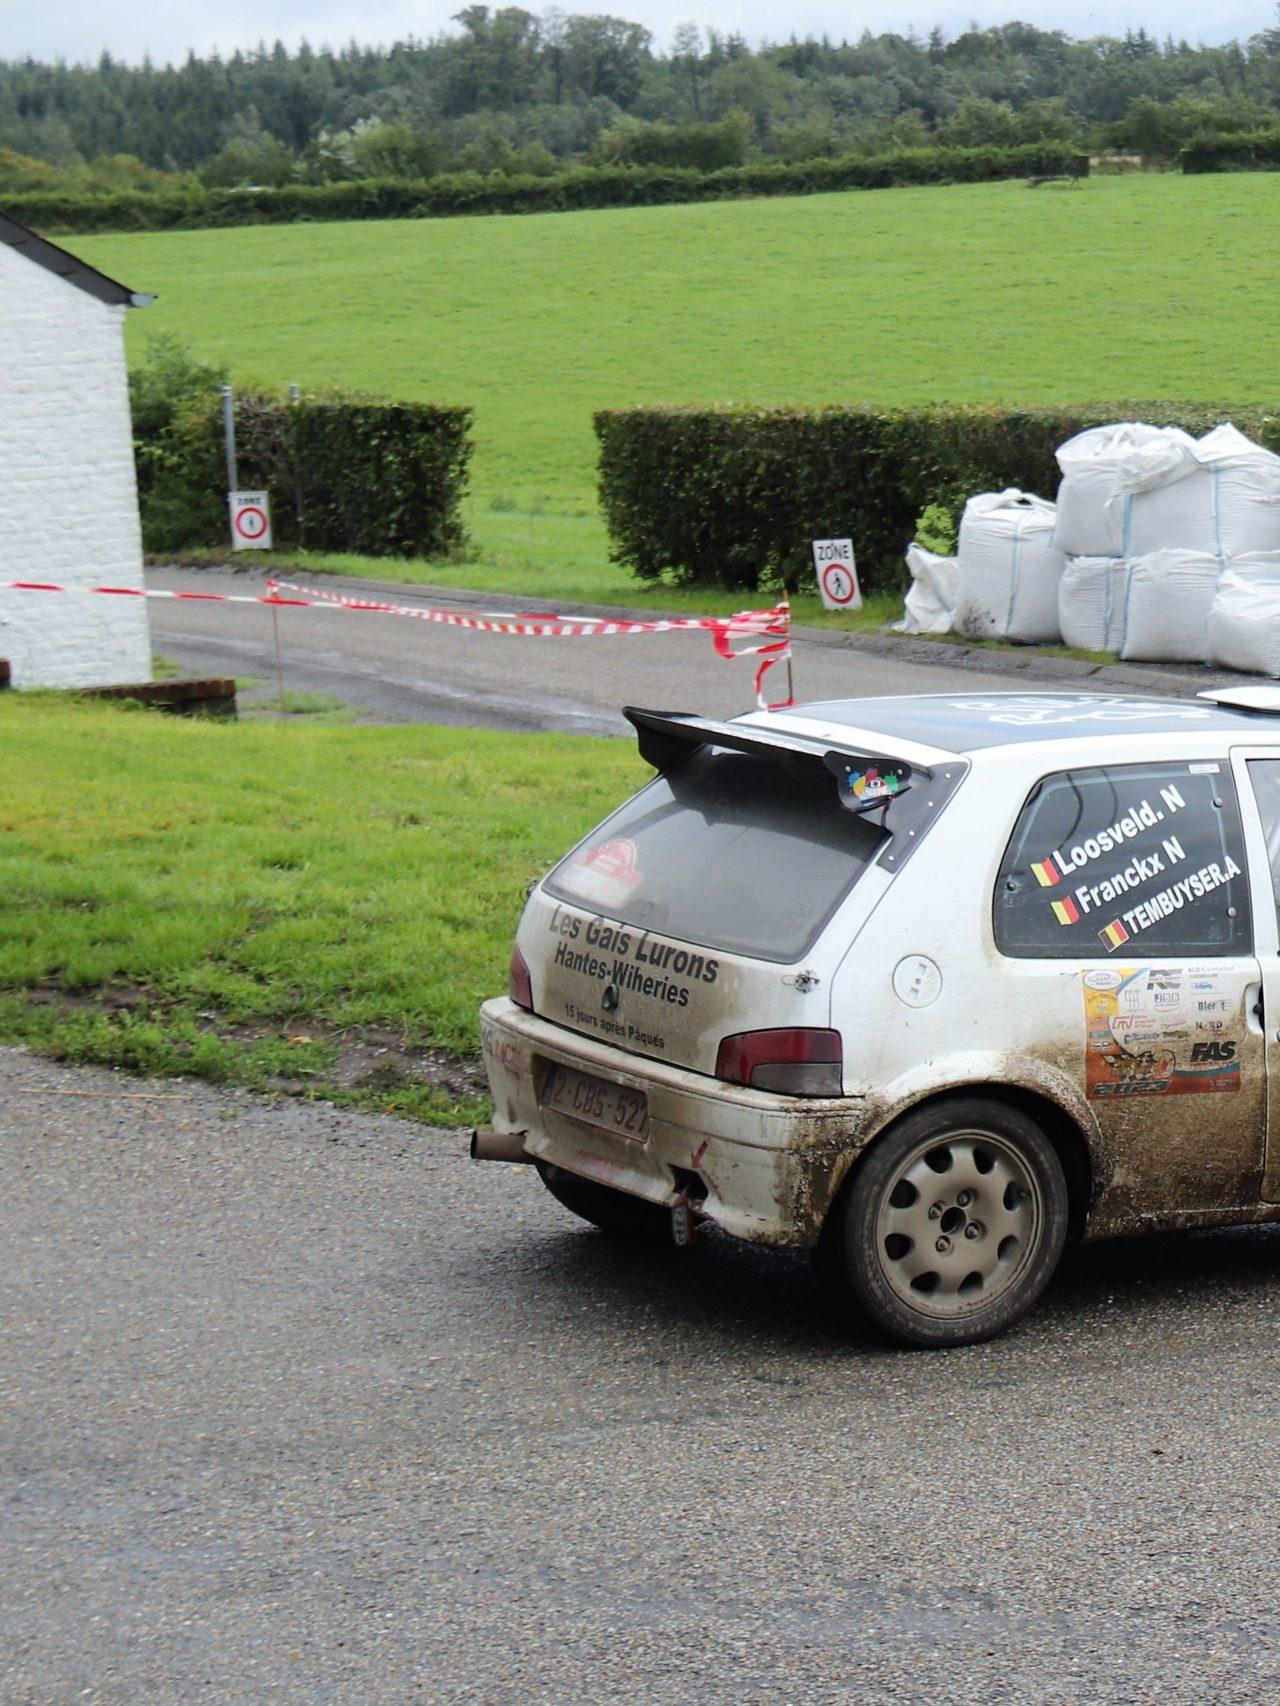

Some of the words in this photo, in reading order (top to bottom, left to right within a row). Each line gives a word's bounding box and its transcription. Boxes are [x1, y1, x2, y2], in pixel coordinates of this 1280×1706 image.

[818, 546, 850, 560] ZONE
[1052, 799, 1165, 876] Loosveld.
[1160, 783, 1186, 815] N
[1075, 851, 1166, 914] Franckx
[1161, 835, 1186, 866] N
[549, 904, 582, 940] Les
[586, 917, 631, 955] Gais
[635, 930, 720, 984] Lurons
[555, 941, 690, 1007] Hantes-Wiheries
[565, 1002, 576, 1018] 15
[576, 1008, 598, 1027] jours
[600, 1015, 626, 1037] après
[1190, 1040, 1237, 1063] FAS
